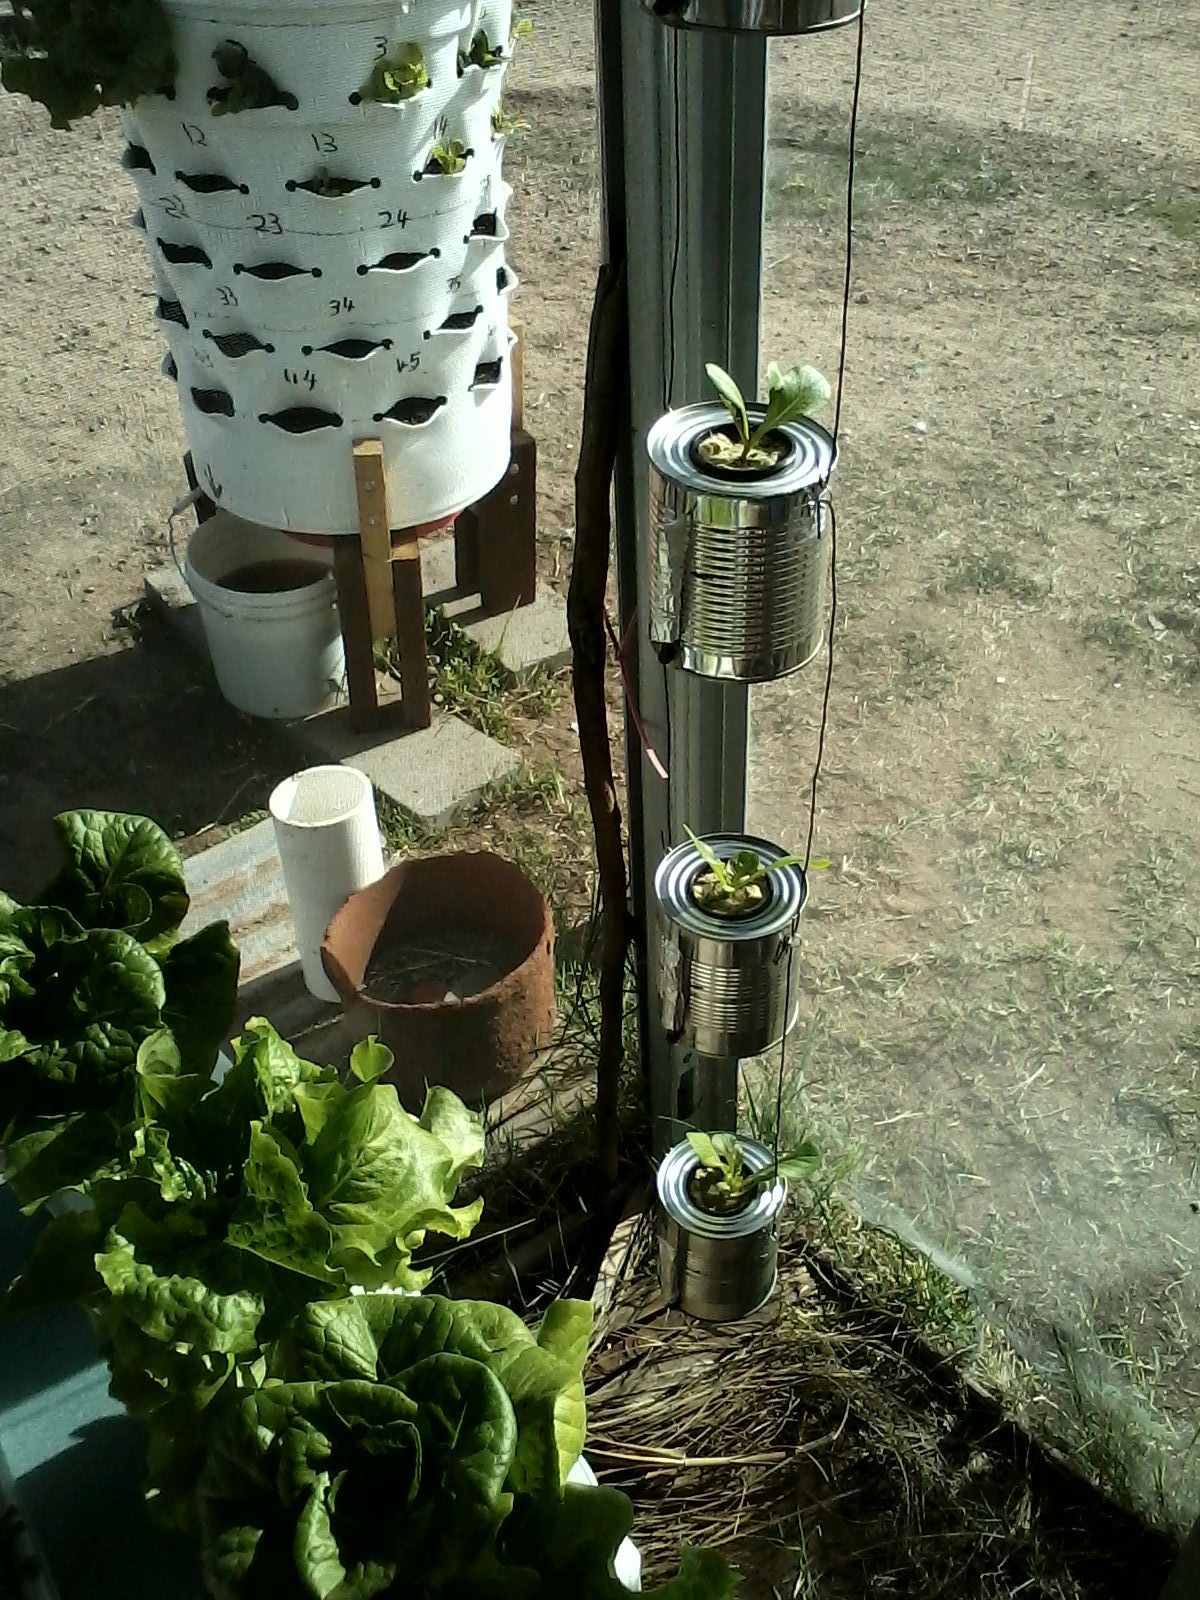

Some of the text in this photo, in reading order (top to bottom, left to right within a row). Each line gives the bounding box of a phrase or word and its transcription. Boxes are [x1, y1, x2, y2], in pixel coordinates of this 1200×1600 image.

[373, 36, 388, 61] 3
[311, 132, 338, 152] 13
[247, 213, 283, 235] 23
[378, 209, 409, 230] 24
[329, 296, 355, 316] 34
